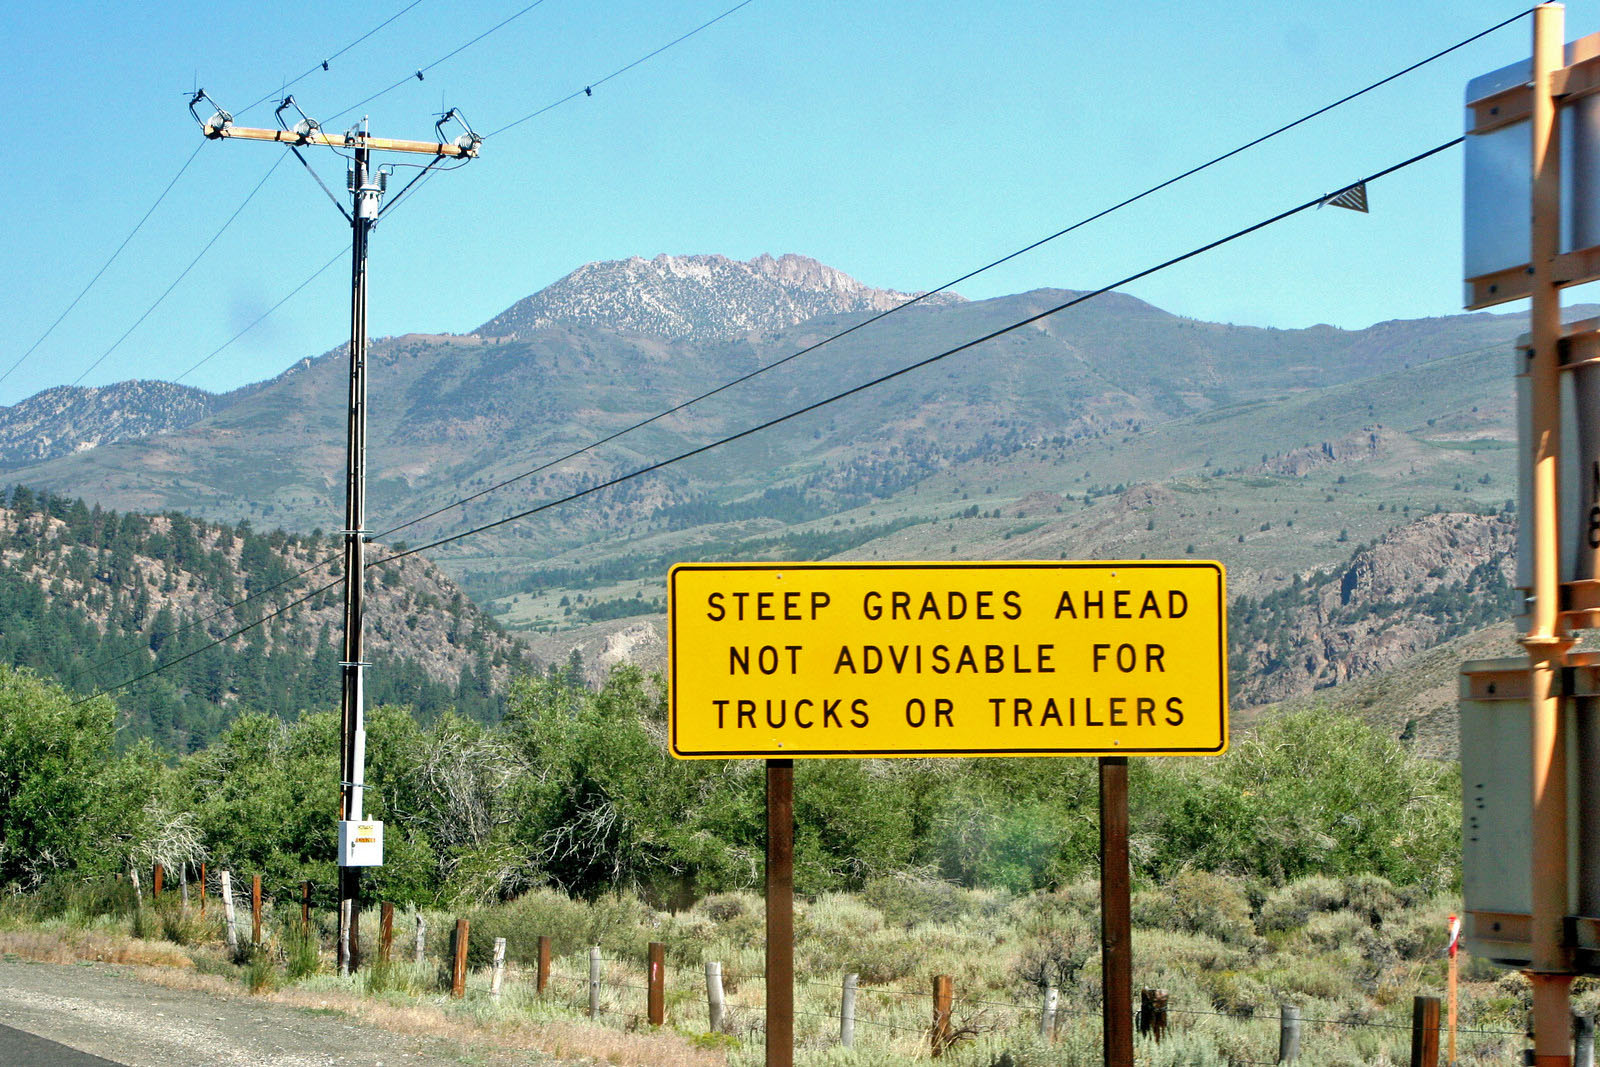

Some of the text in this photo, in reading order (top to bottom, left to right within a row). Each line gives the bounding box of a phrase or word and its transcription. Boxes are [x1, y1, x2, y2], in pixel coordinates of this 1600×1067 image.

[707, 590, 1188, 622] STEEP GRADES AHEAD
[730, 643, 1165, 675] NOT ADVISABLE FOR
[712, 696, 1184, 729] TRUCKS OR TRAILERS
